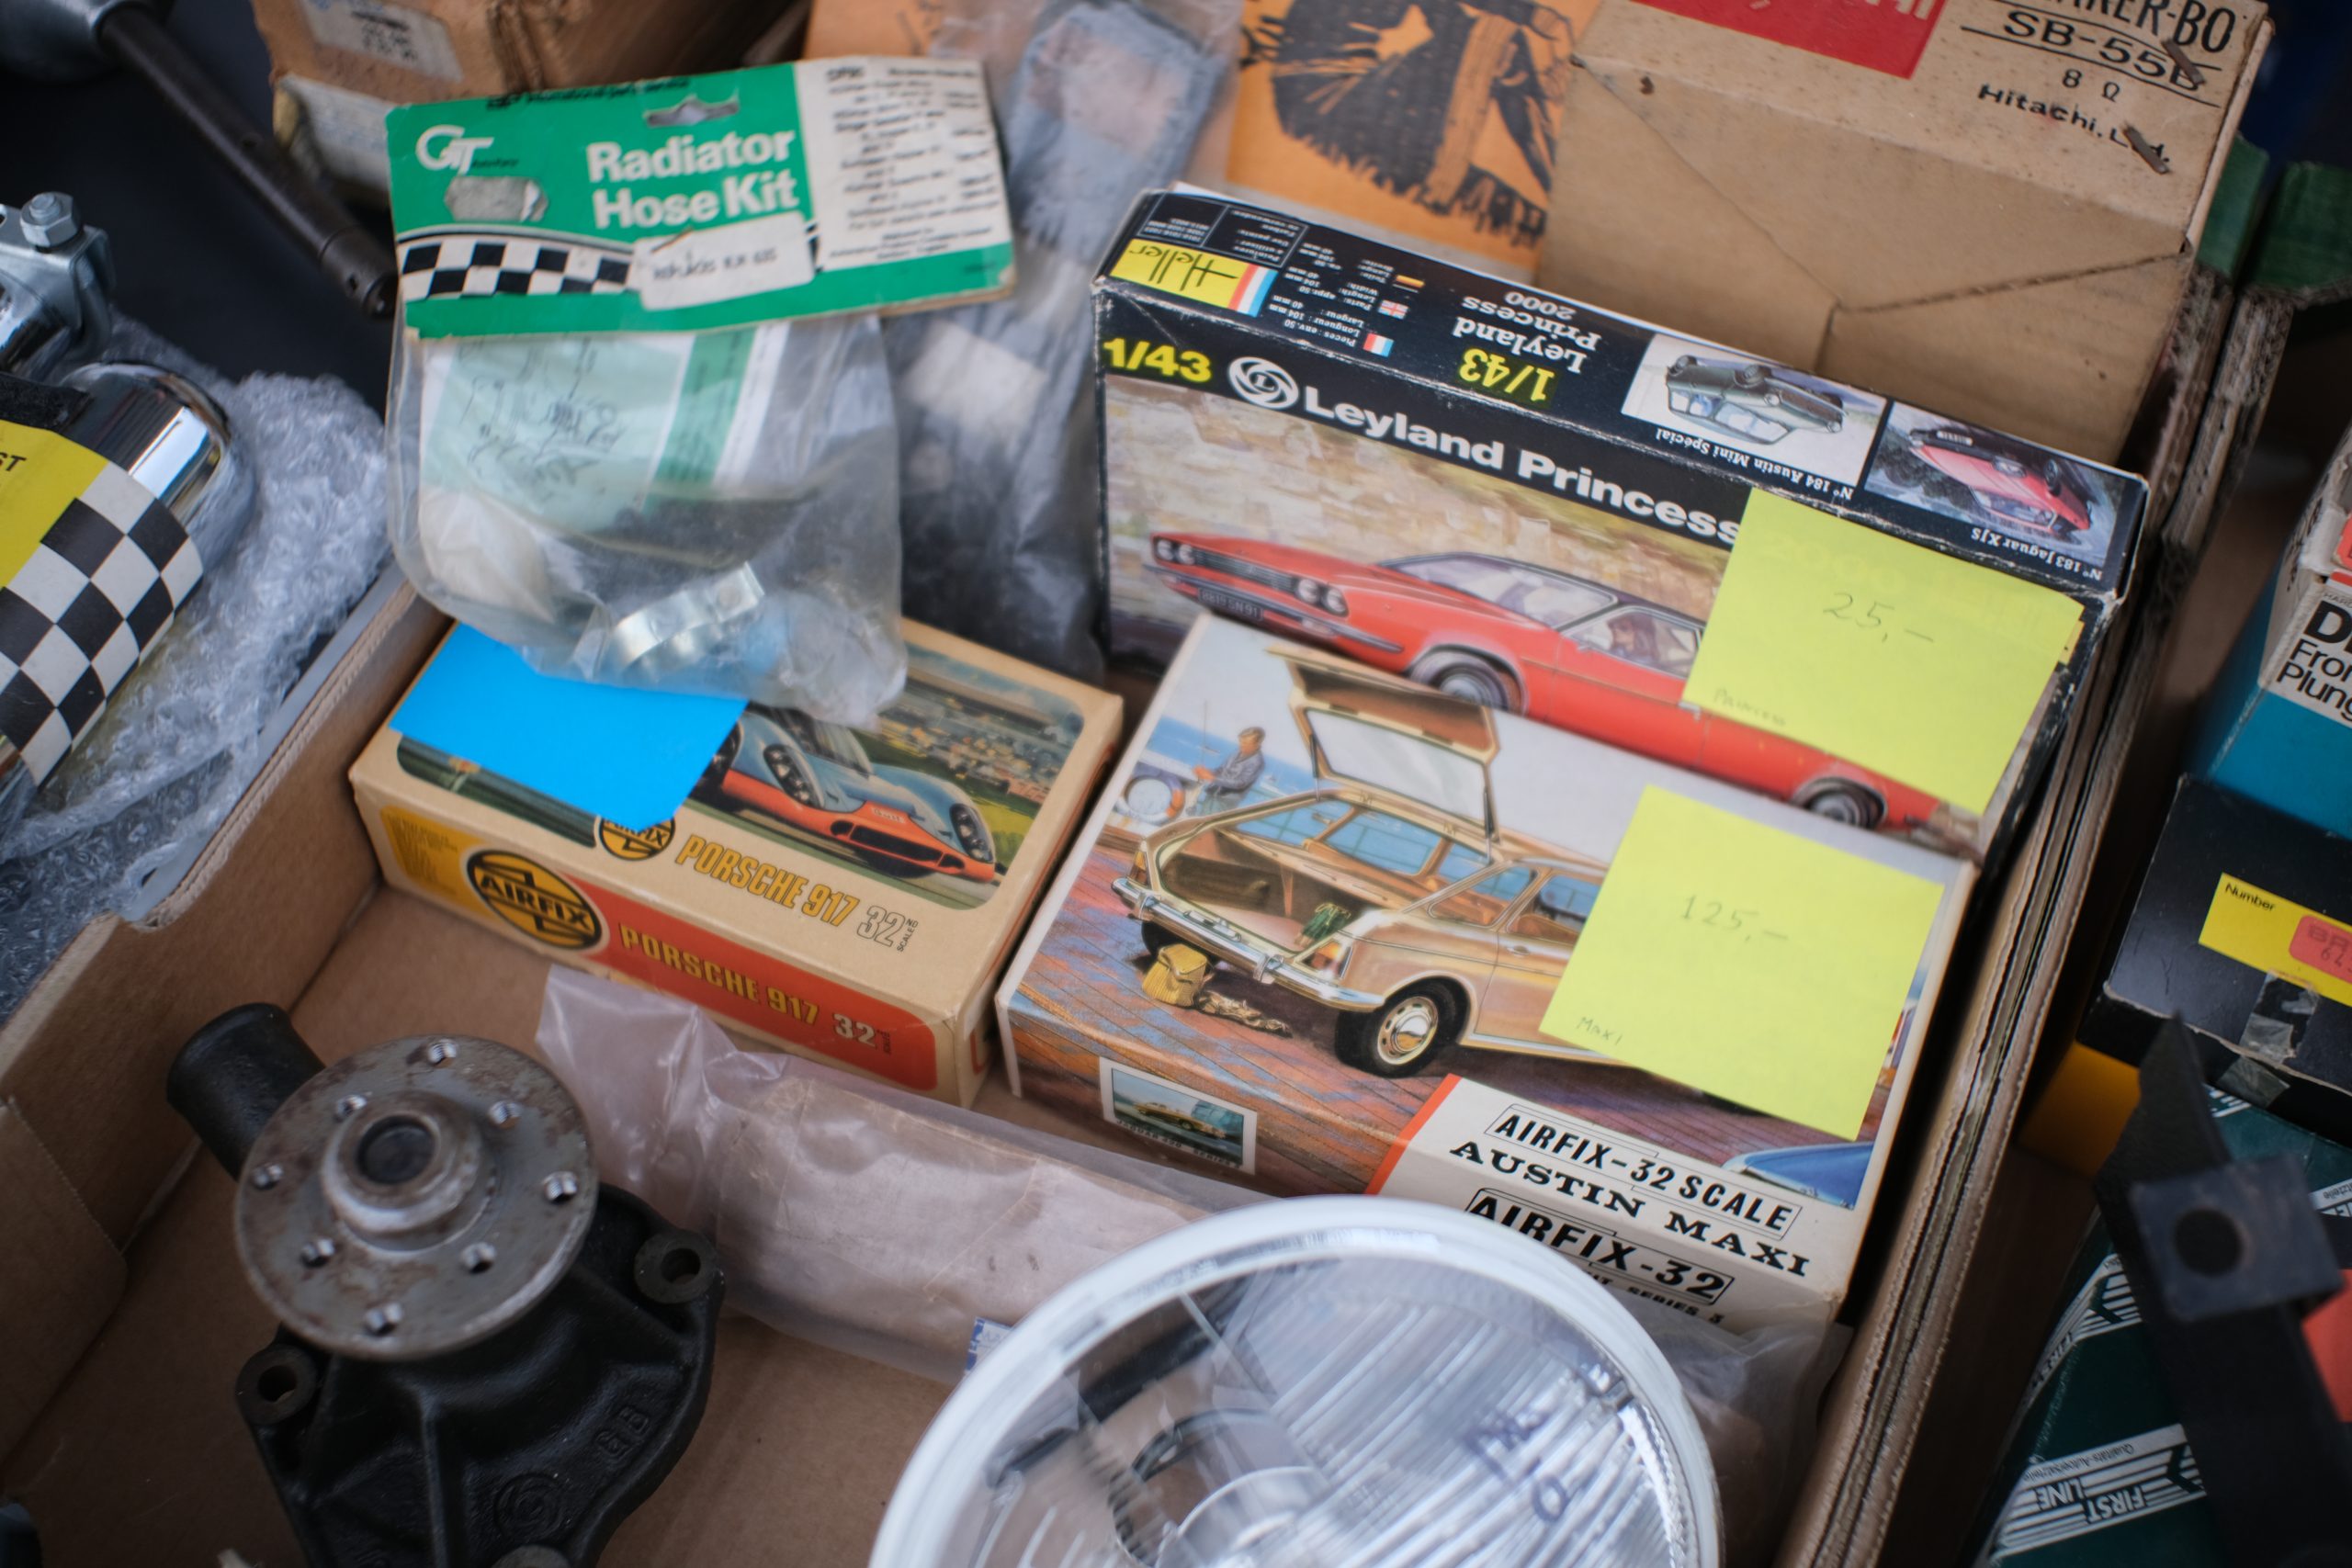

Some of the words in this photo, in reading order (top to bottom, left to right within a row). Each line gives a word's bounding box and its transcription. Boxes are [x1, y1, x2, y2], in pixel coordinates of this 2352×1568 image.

[2062, 69, 2083, 88] 8
[415, 124, 494, 175] GT
[585, 130, 797, 183] Radiator
[2110, 127, 2170, 164] Ld.
[592, 186, 721, 231] Hose
[722, 168, 800, 218] Kit
[1129, 245, 1238, 292] Heller
[1268, 303, 1288, 315] mm
[1272, 294, 1292, 305] mm
[1287, 310, 1306, 321] 104
[1291, 300, 1305, 310] 40
[1504, 291, 1577, 321] 2000
[1313, 316, 1362, 338] Longueur
[1462, 296, 1602, 352] Princess
[1453, 316, 1588, 375] Leyland
[1459, 348, 1555, 401] 1/43
[1102, 336, 1213, 383] 1/43
[1304, 387, 1505, 471] Leyland
[1516, 448, 1740, 547] Princess
[1713, 446, 1750, 468] Mini
[1753, 457, 1804, 484] Austin
[1805, 473, 1831, 493] 184
[2003, 536, 2057, 565] Jaguar
[2054, 552, 2083, 574] 183
[480, 873, 592, 931] AIRFIX
[674, 833, 809, 909] PORSCHE
[800, 883, 860, 928] 917
[856, 905, 907, 948] 32
[2224, 882, 2277, 912] Number
[617, 921, 762, 1005] PORSCHE
[765, 985, 821, 1027] 917
[831, 1011, 878, 1049] 32
[1494, 1112, 1677, 1191] AIRFIX-32
[1679, 1174, 1794, 1232] SCALE
[1449, 1140, 1646, 1219] AUSTIN
[1664, 1210, 1810, 1278] MAXI
[1468, 1194, 1727, 1301] AIRFIX-32
[1626, 1285, 1700, 1317] SERIES
[2036, 1477, 2086, 1512] LINE
[2086, 1484, 2147, 1523] FIRST
